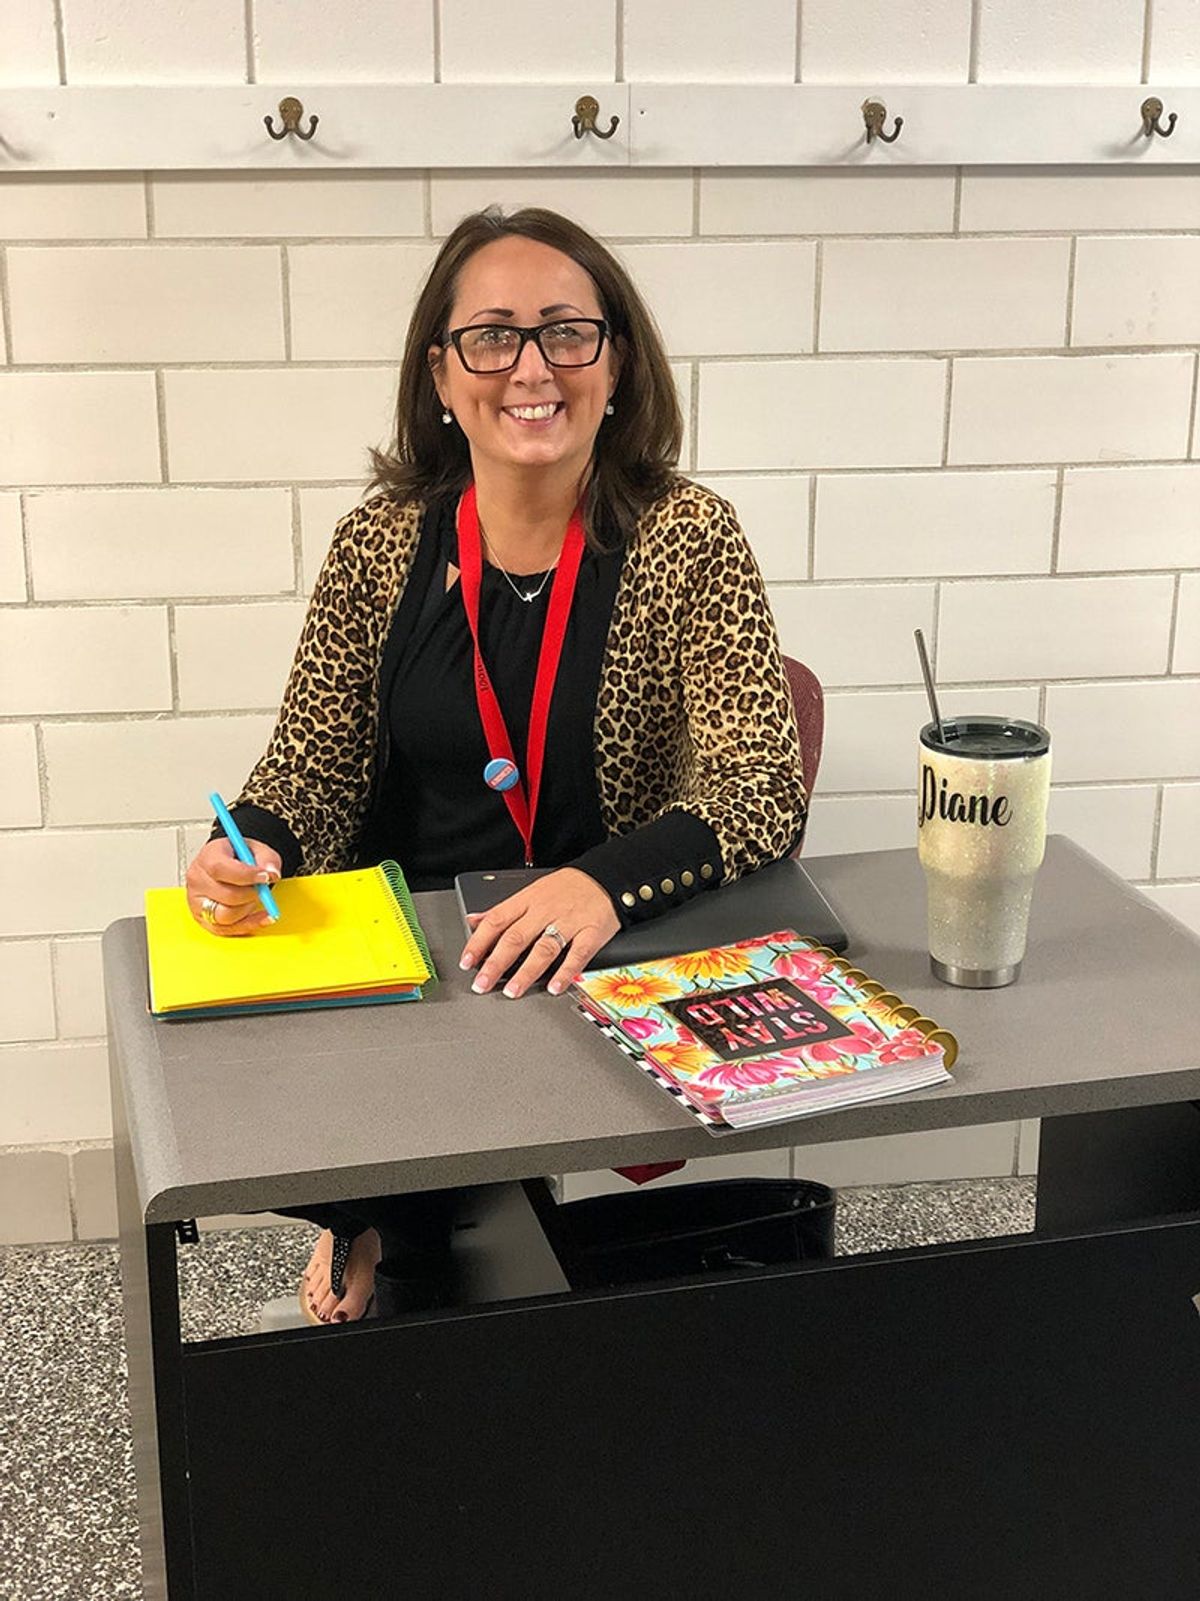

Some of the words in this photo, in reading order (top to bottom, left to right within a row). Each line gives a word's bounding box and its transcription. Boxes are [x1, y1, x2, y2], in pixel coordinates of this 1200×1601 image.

[918, 764, 1013, 828] Diane
[686, 988, 803, 1026] WILD
[721, 1010, 829, 1051] STAY
